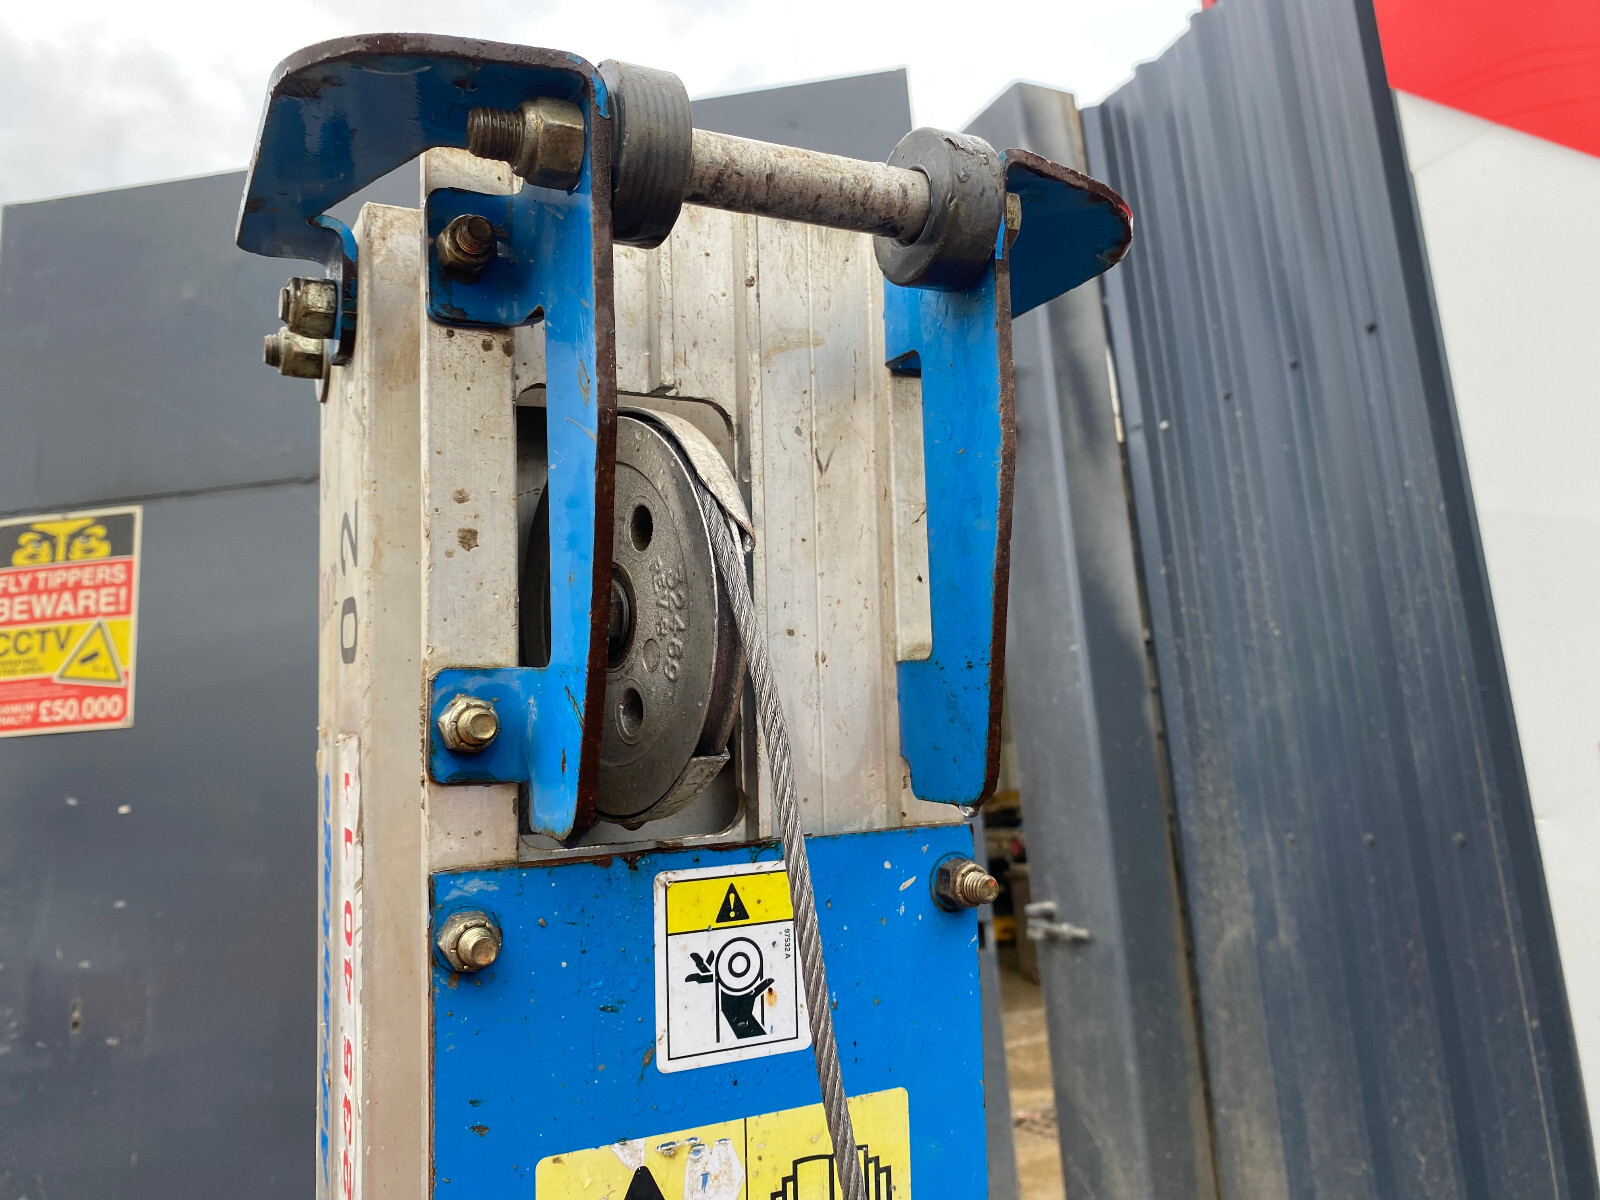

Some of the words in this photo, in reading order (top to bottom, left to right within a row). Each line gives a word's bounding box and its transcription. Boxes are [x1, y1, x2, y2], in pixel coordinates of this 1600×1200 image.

[0, 572, 33, 595] FLY
[35, 564, 128, 592] TIPPERS
[0, 587, 128, 623] BEWARE!
